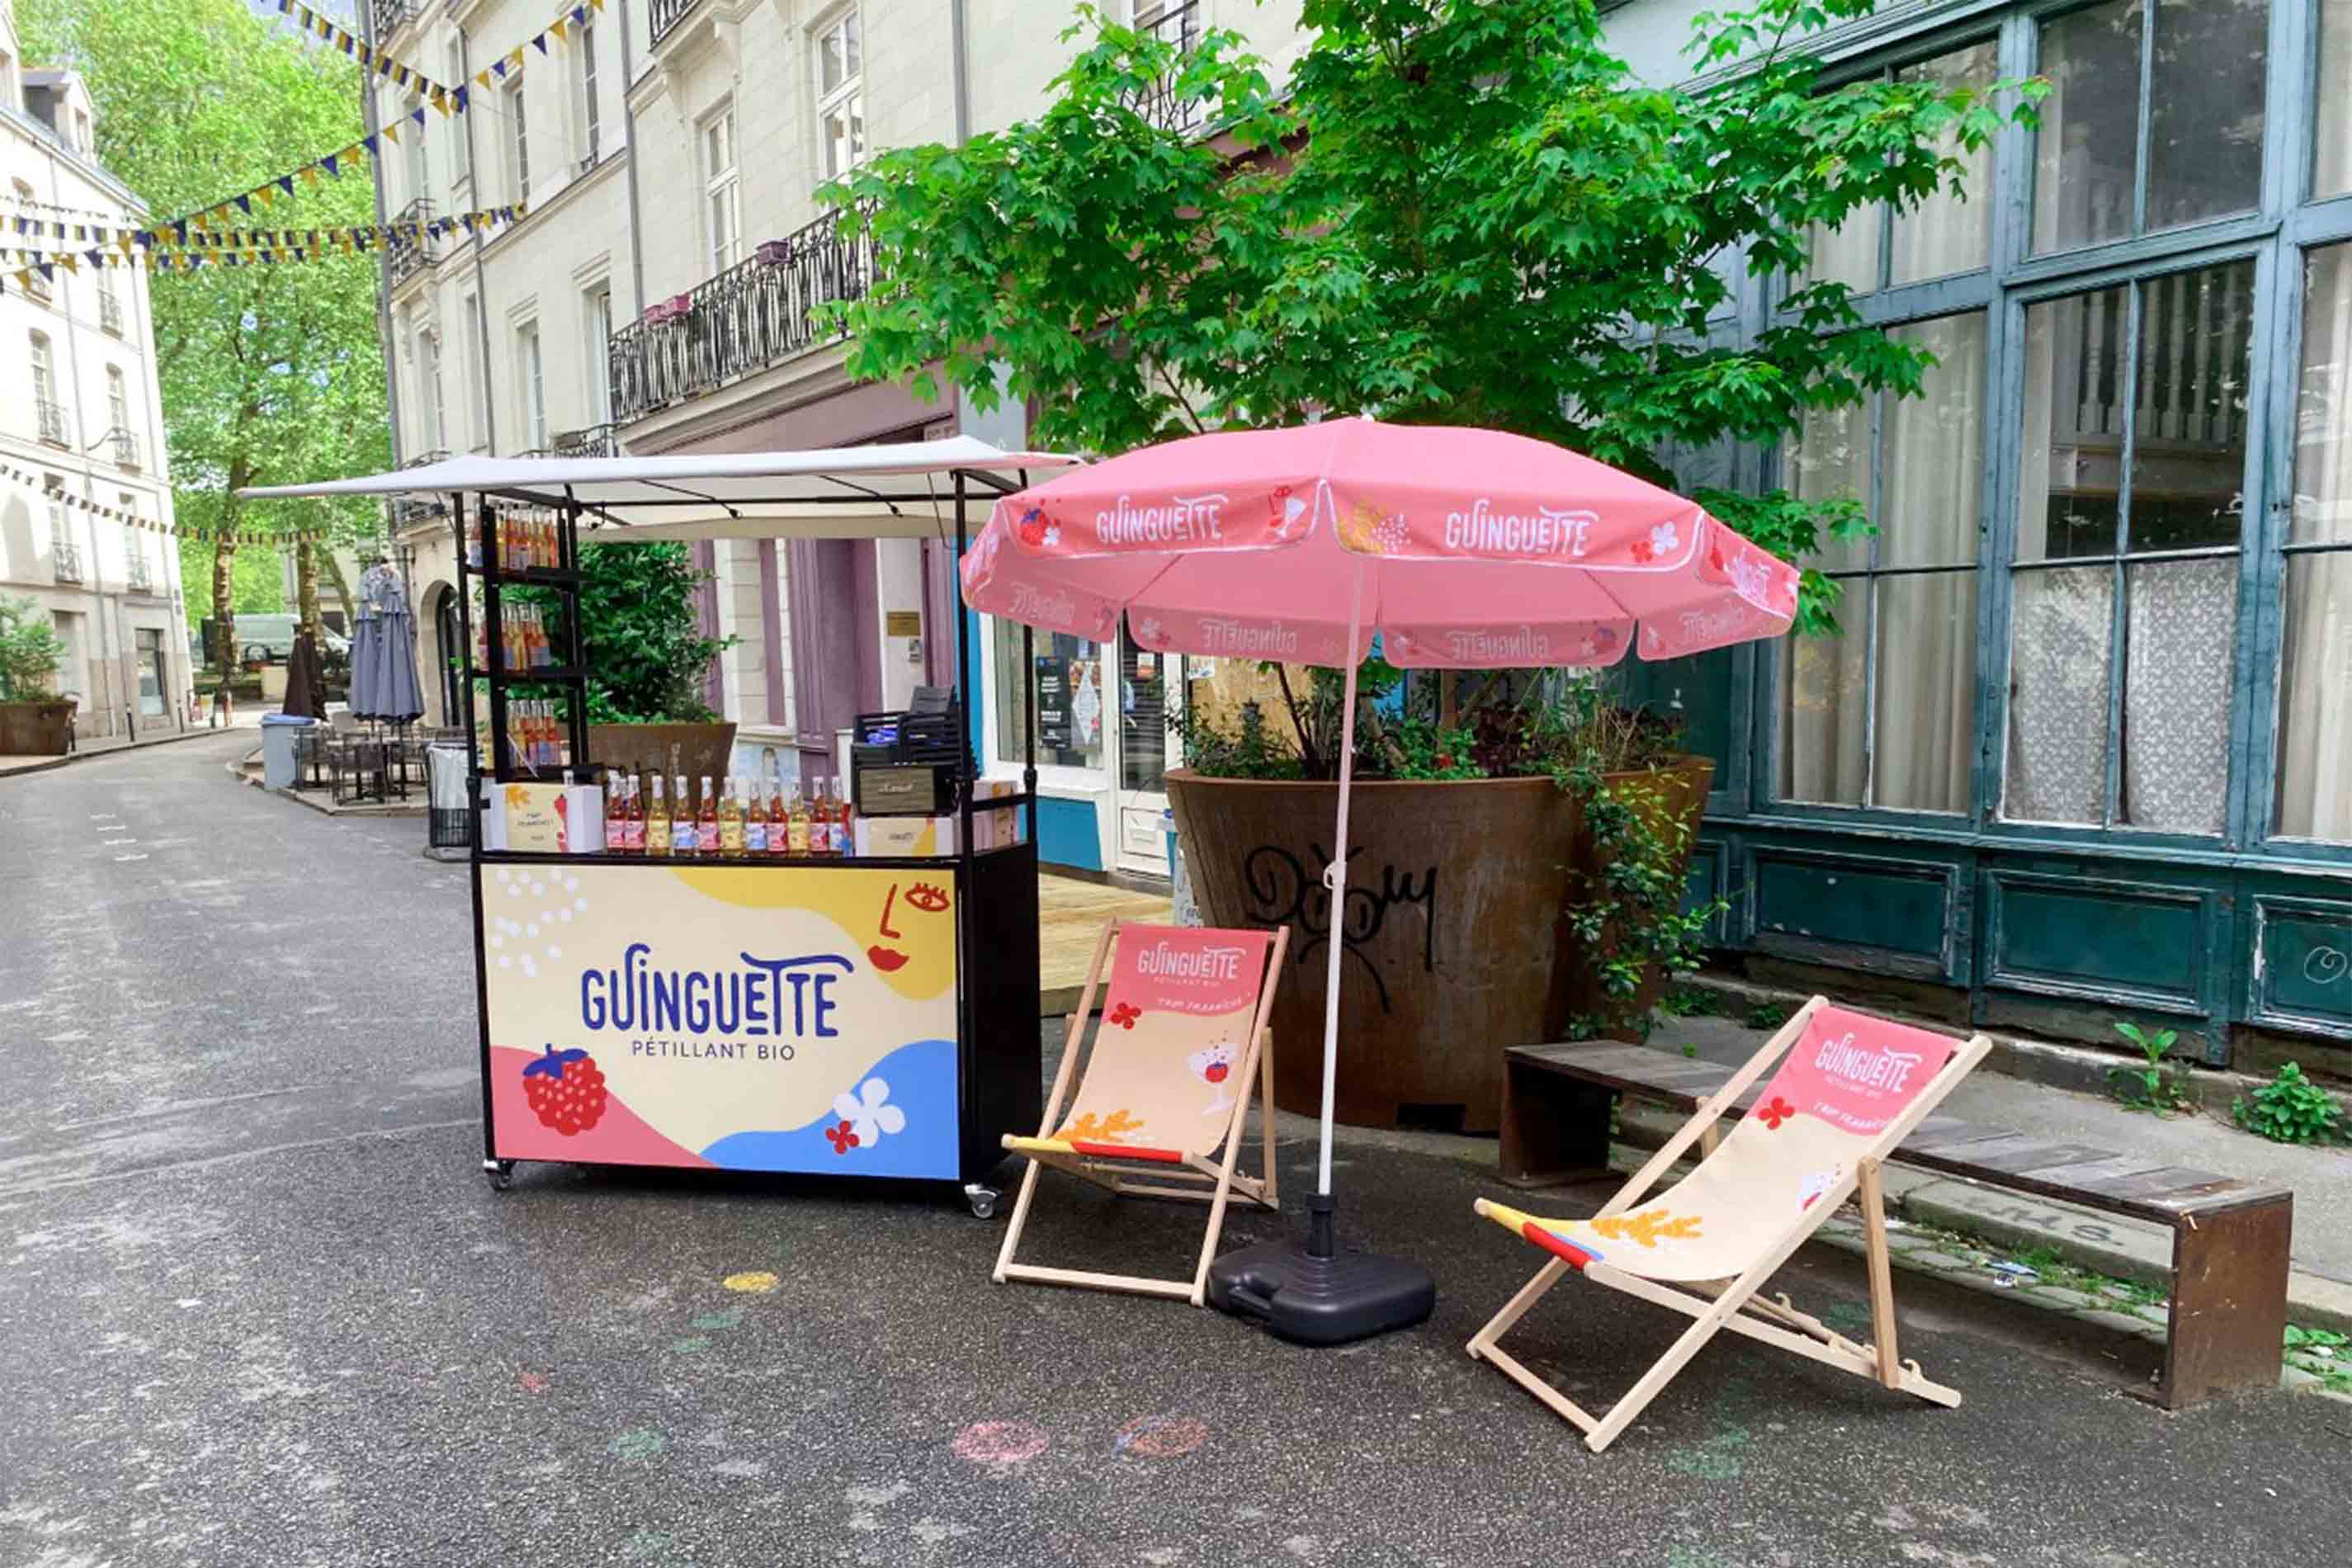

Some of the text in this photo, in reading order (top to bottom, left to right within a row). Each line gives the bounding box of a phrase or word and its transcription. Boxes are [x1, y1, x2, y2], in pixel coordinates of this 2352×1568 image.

[1096, 494, 1228, 545] GUINGUETTE
[1445, 498, 1599, 557] GUINGUETTE
[581, 942, 855, 1037] GUINGUETTE
[632, 1037, 796, 1061] PÉTILLANT BIO
